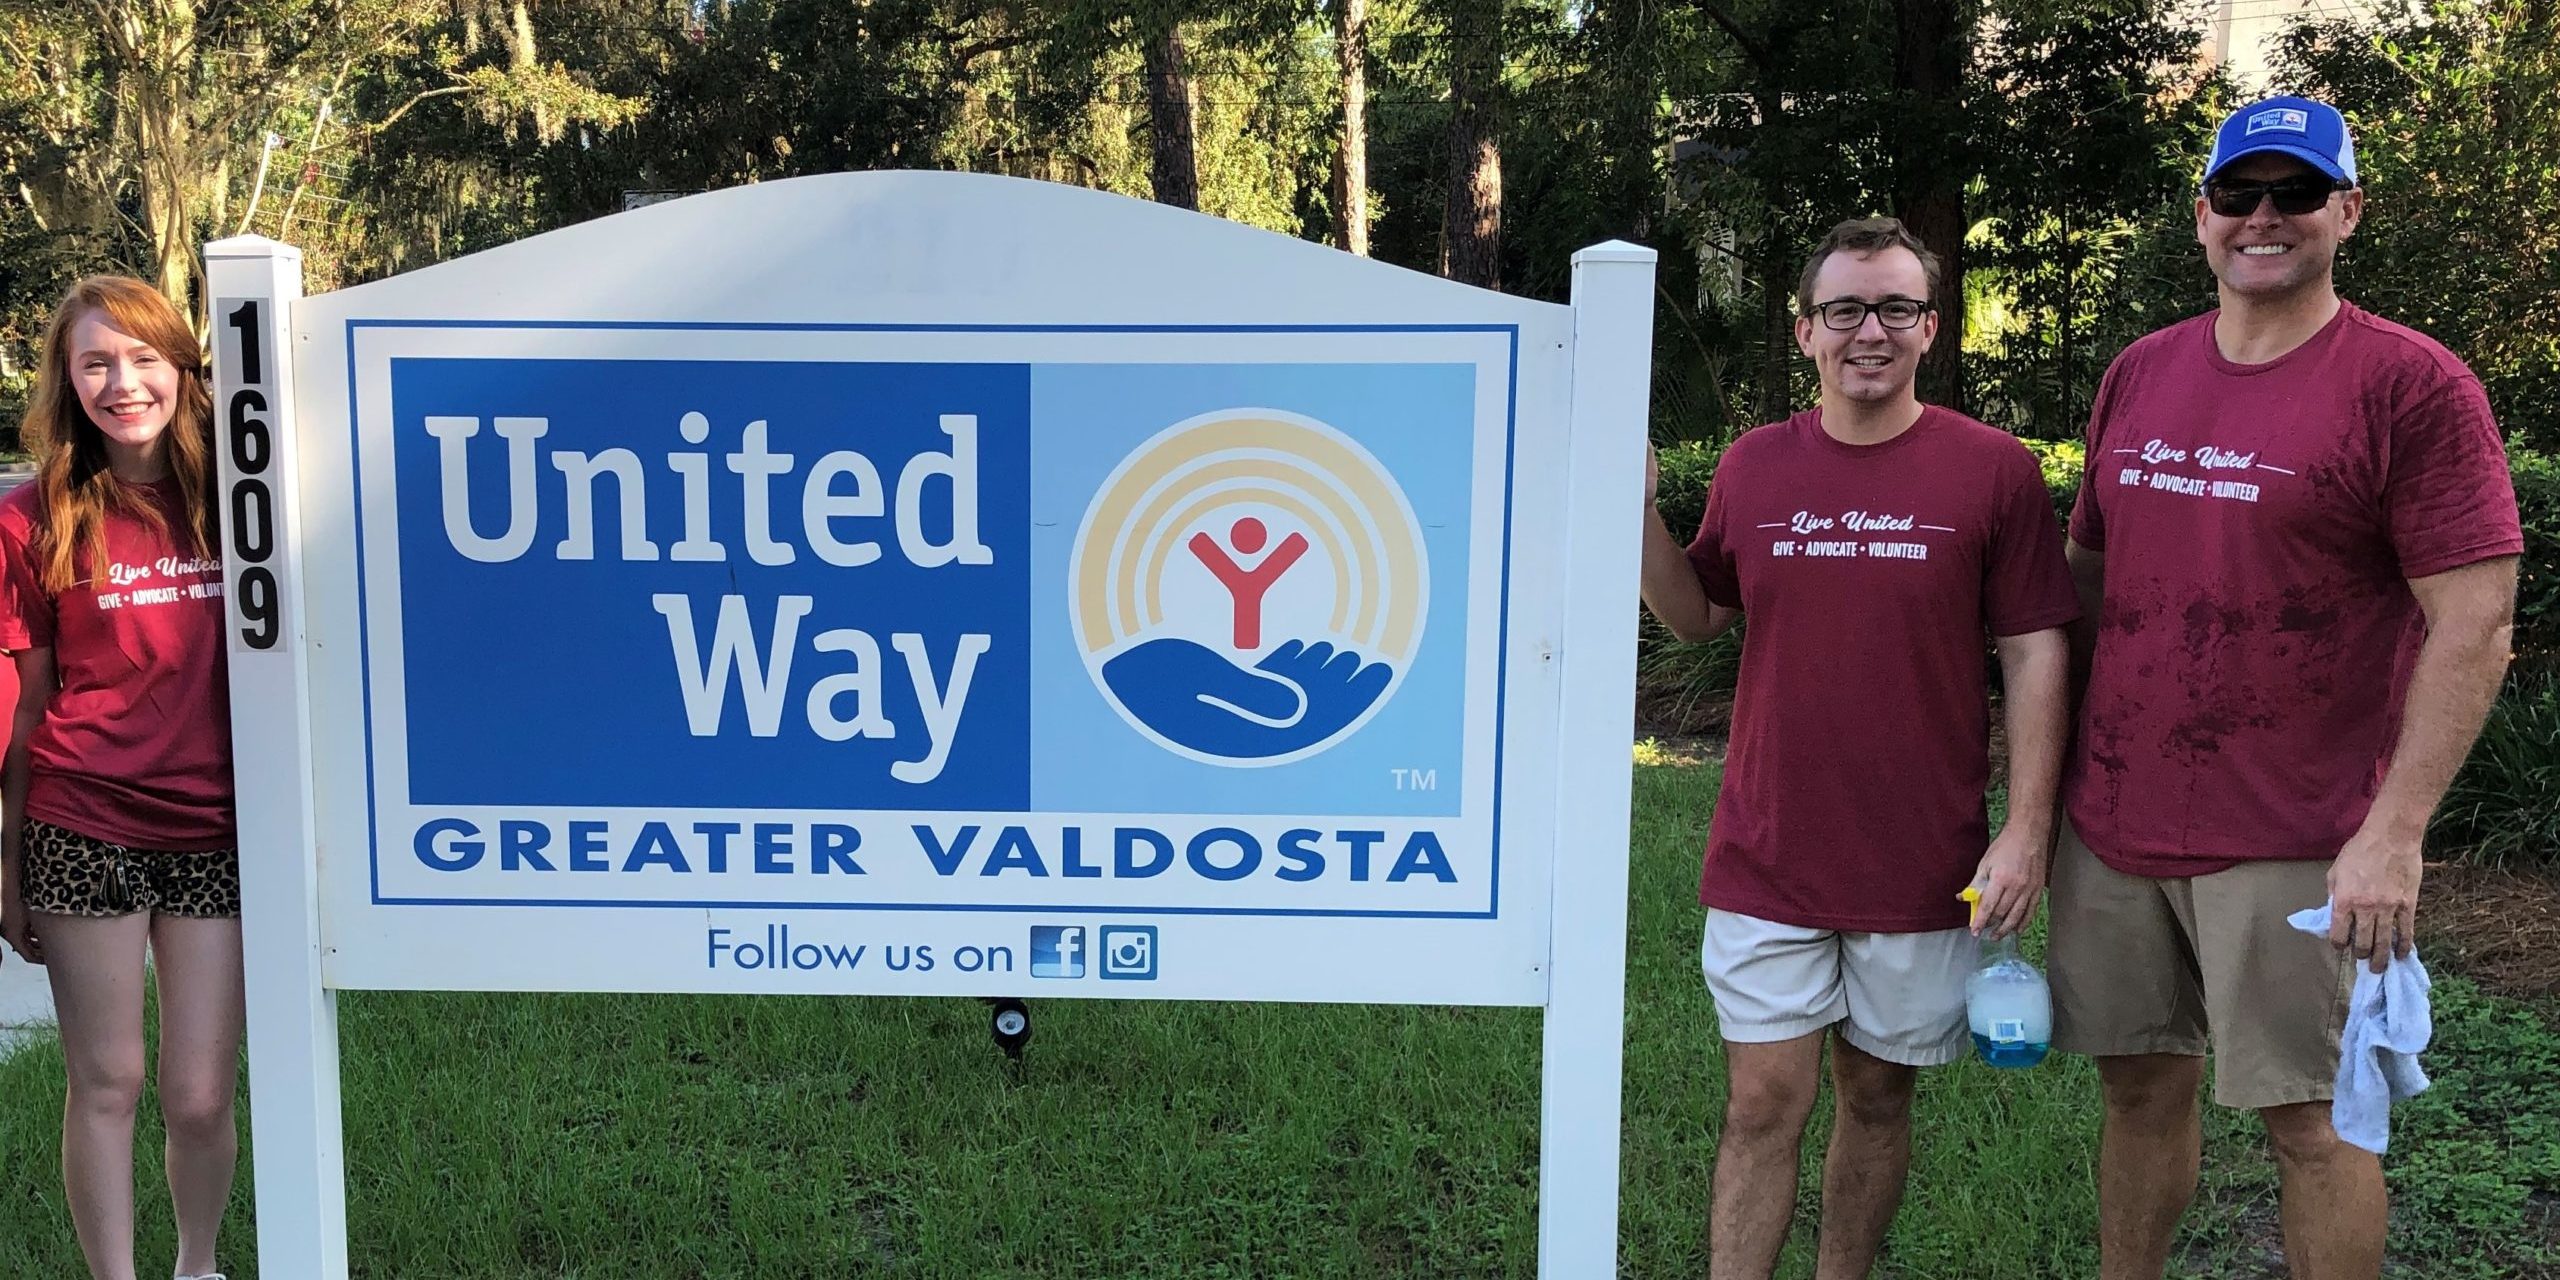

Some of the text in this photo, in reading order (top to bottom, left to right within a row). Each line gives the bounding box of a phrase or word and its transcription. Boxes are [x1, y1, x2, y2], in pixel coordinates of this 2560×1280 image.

[2252, 112, 2280, 123] United
[2141, 439, 2255, 470] Live United
[229, 300, 280, 650] 1609
[424, 411, 994, 568] United
[2119, 468, 2260, 502] GIVE ADVOCATE VOLUNTEER
[1791, 510, 1914, 535] Live United
[1772, 541, 1928, 560] GIVE ADVOCATE VOLUNTEER
[109, 562, 152, 586] Live
[97, 592, 122, 610] GIVE
[132, 586, 180, 606] ADVOCATE
[652, 593, 992, 784] Way
[1391, 768, 1437, 792] TM
[413, 817, 1459, 884] GREATER VALDOSTA
[707, 924, 867, 970] Follow
[885, 943, 935, 972] us
[953, 943, 1014, 973] on
